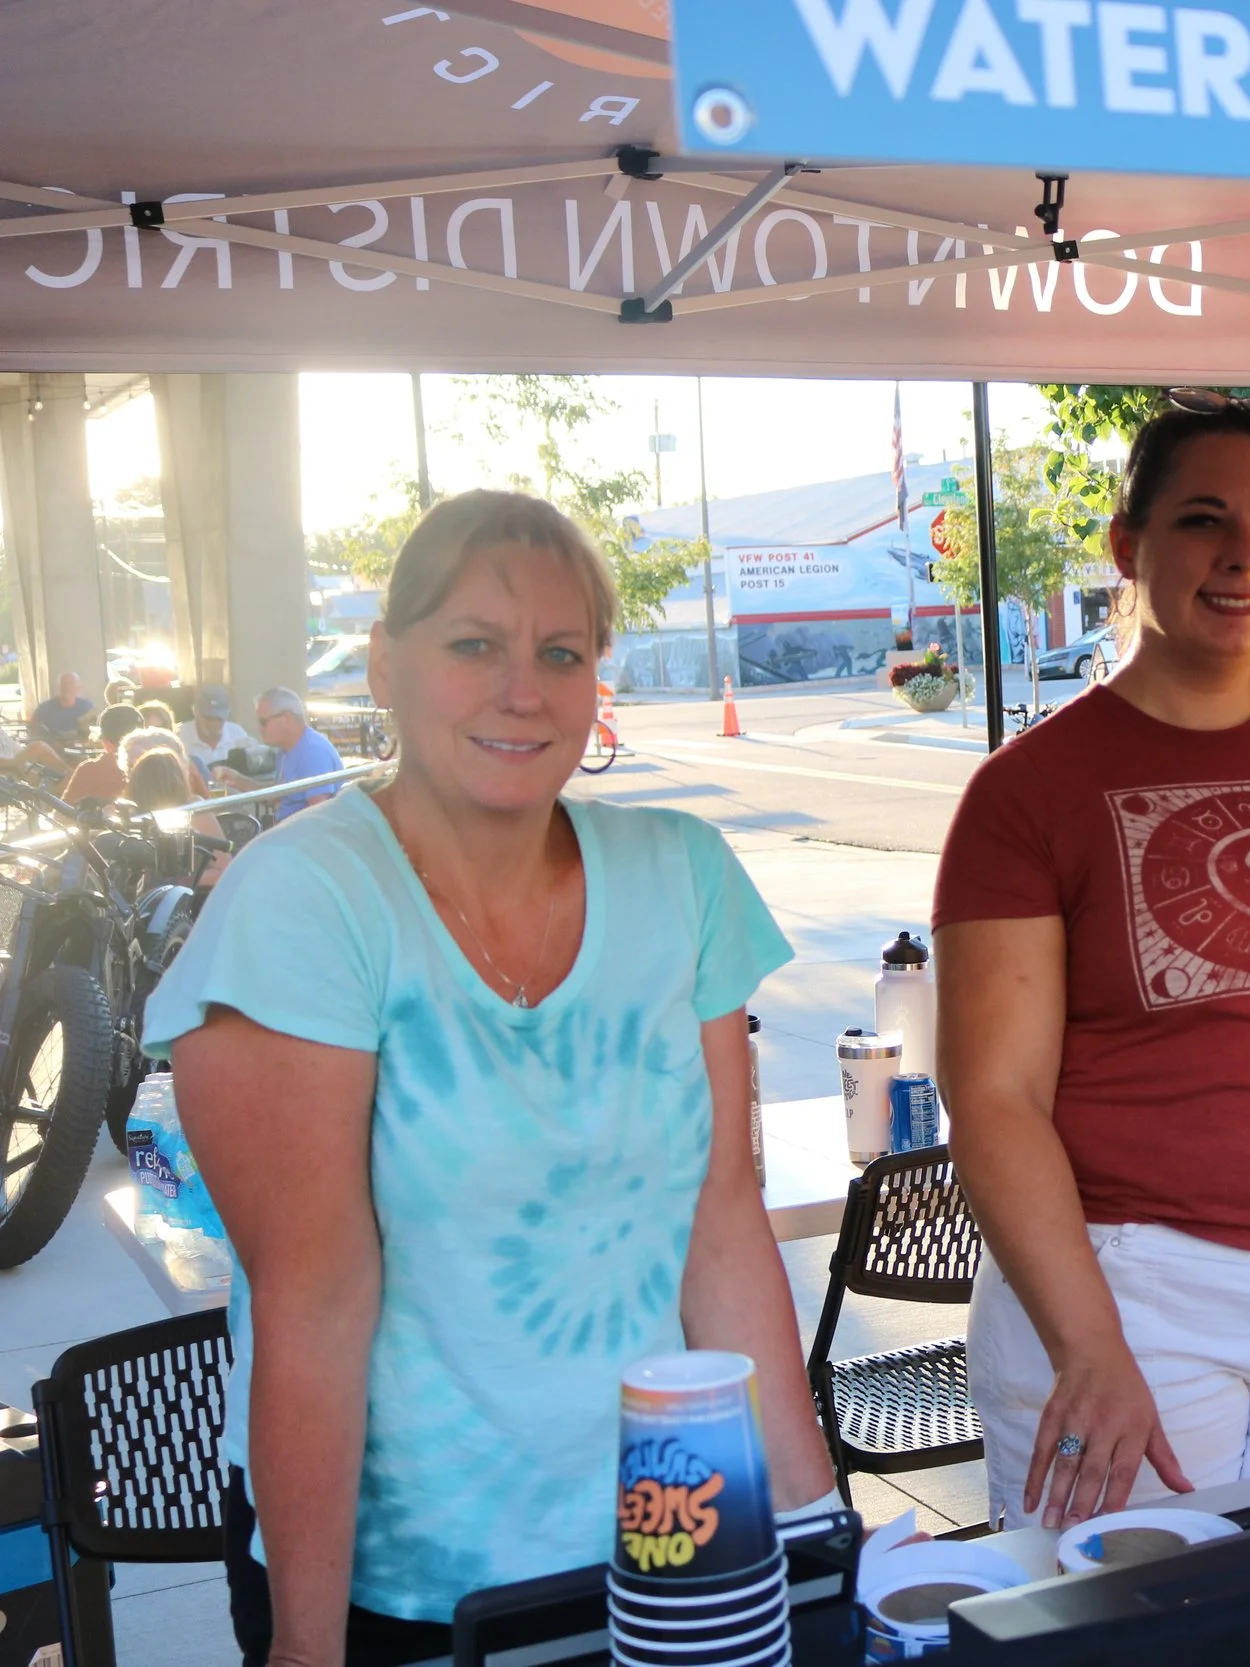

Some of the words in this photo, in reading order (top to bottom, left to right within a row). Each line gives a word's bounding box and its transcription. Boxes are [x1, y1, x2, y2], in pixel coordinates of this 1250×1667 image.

[739, 553, 762, 563] VFW
[768, 552, 798, 562] POST
[803, 552, 815, 561] 41
[740, 565, 795, 576] AMERICAN
[800, 563, 839, 574] LEGION
[741, 579, 769, 589] POST
[774, 579, 785, 588] 15
[621, 1532, 695, 1572] ONE
